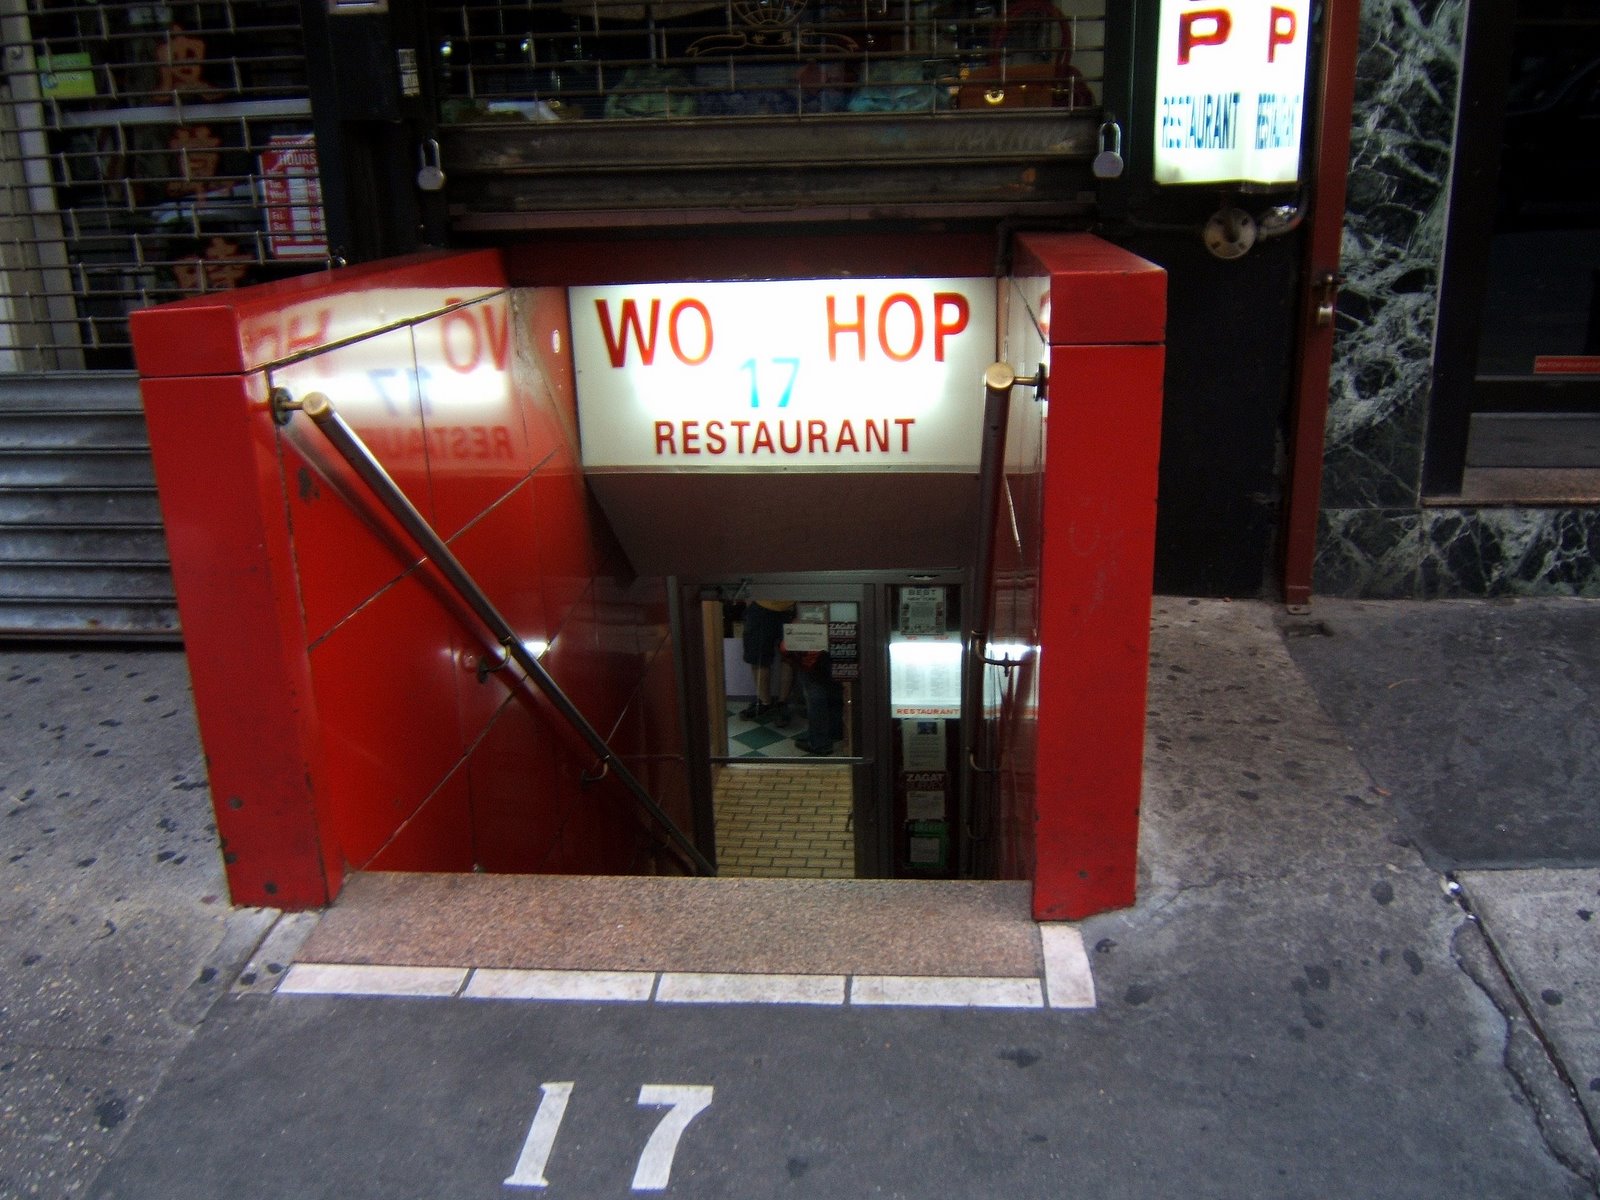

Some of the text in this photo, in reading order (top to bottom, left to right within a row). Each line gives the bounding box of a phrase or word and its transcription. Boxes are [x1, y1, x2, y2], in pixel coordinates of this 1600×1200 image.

[594, 291, 971, 369] WO HOP
[739, 356, 799, 409] 17
[653, 418, 917, 456] RESTAURANT
